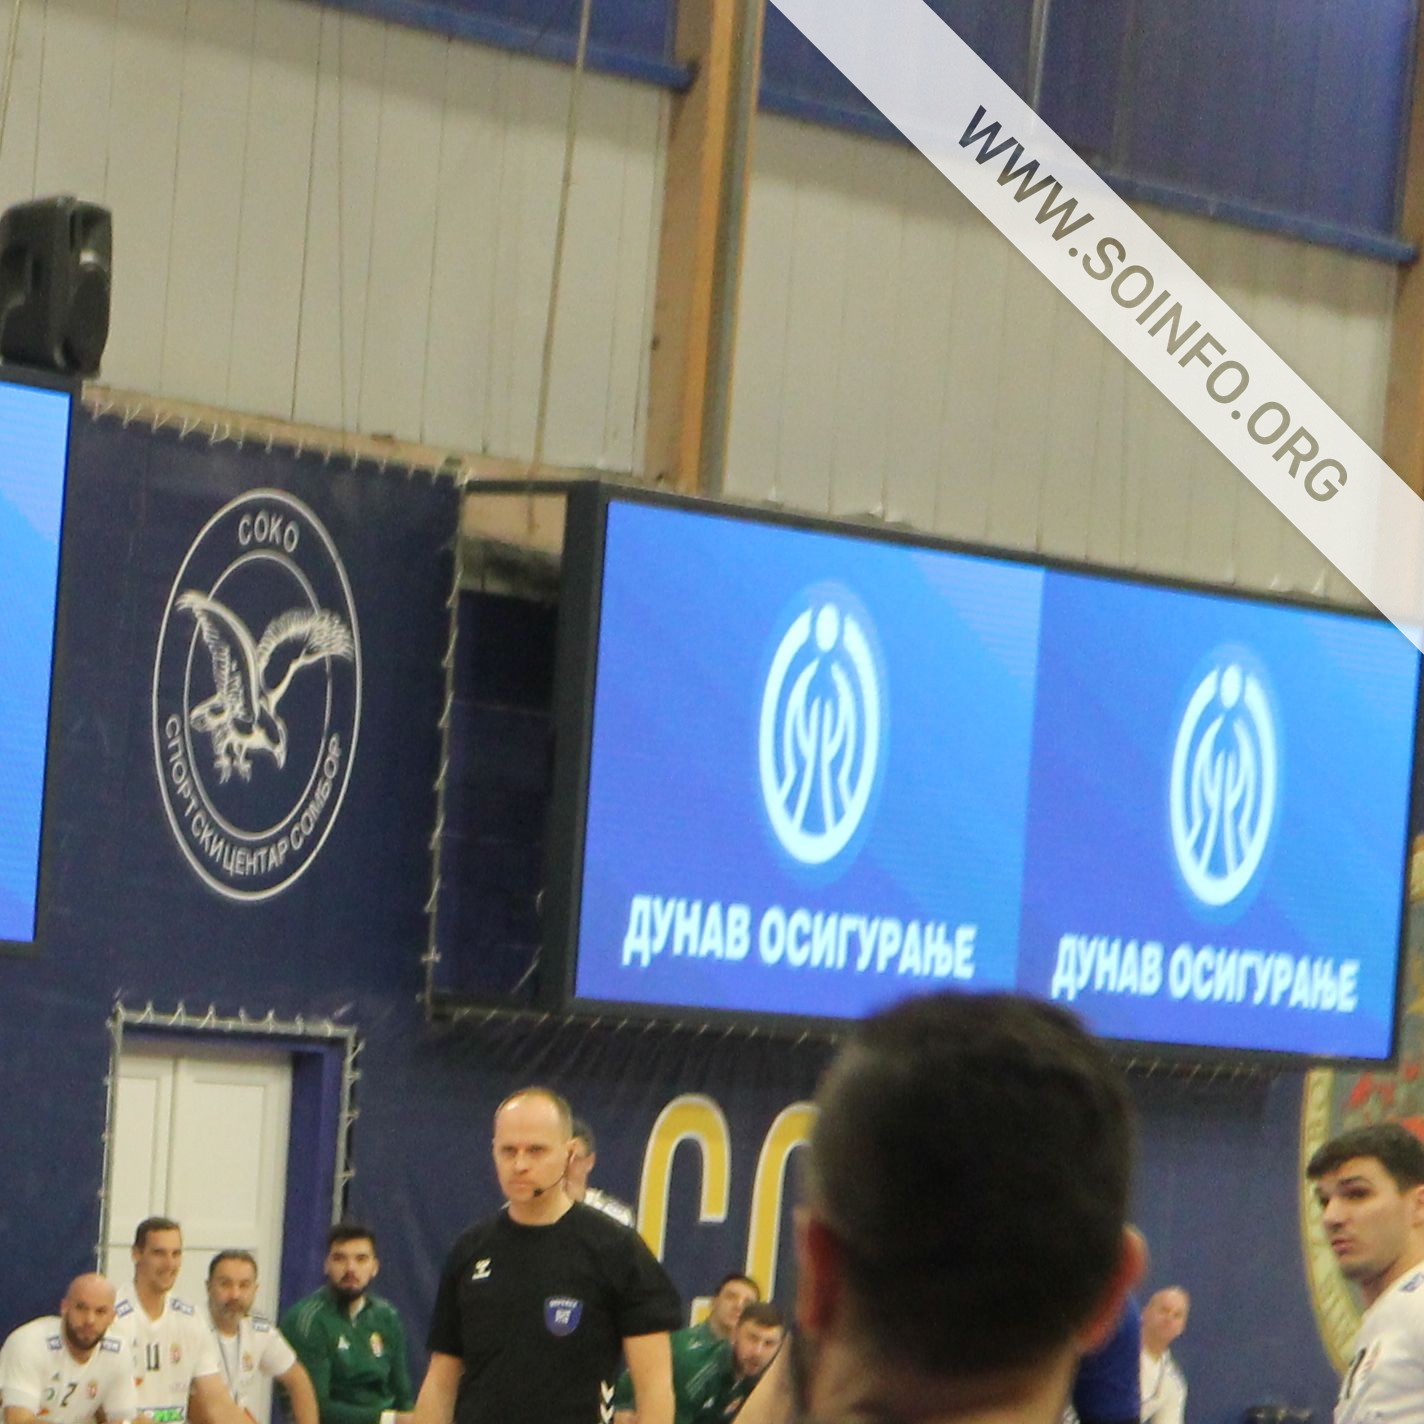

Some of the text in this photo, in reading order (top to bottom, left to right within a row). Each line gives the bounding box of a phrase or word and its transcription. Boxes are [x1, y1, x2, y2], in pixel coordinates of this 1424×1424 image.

[239, 510, 300, 553] СОКО
[623, 897, 975, 977] ДУНАВ ОСИГУРАЊЕ
[1052, 937, 1357, 1010] ДУНАВ ОСИГУРАЊЕ
